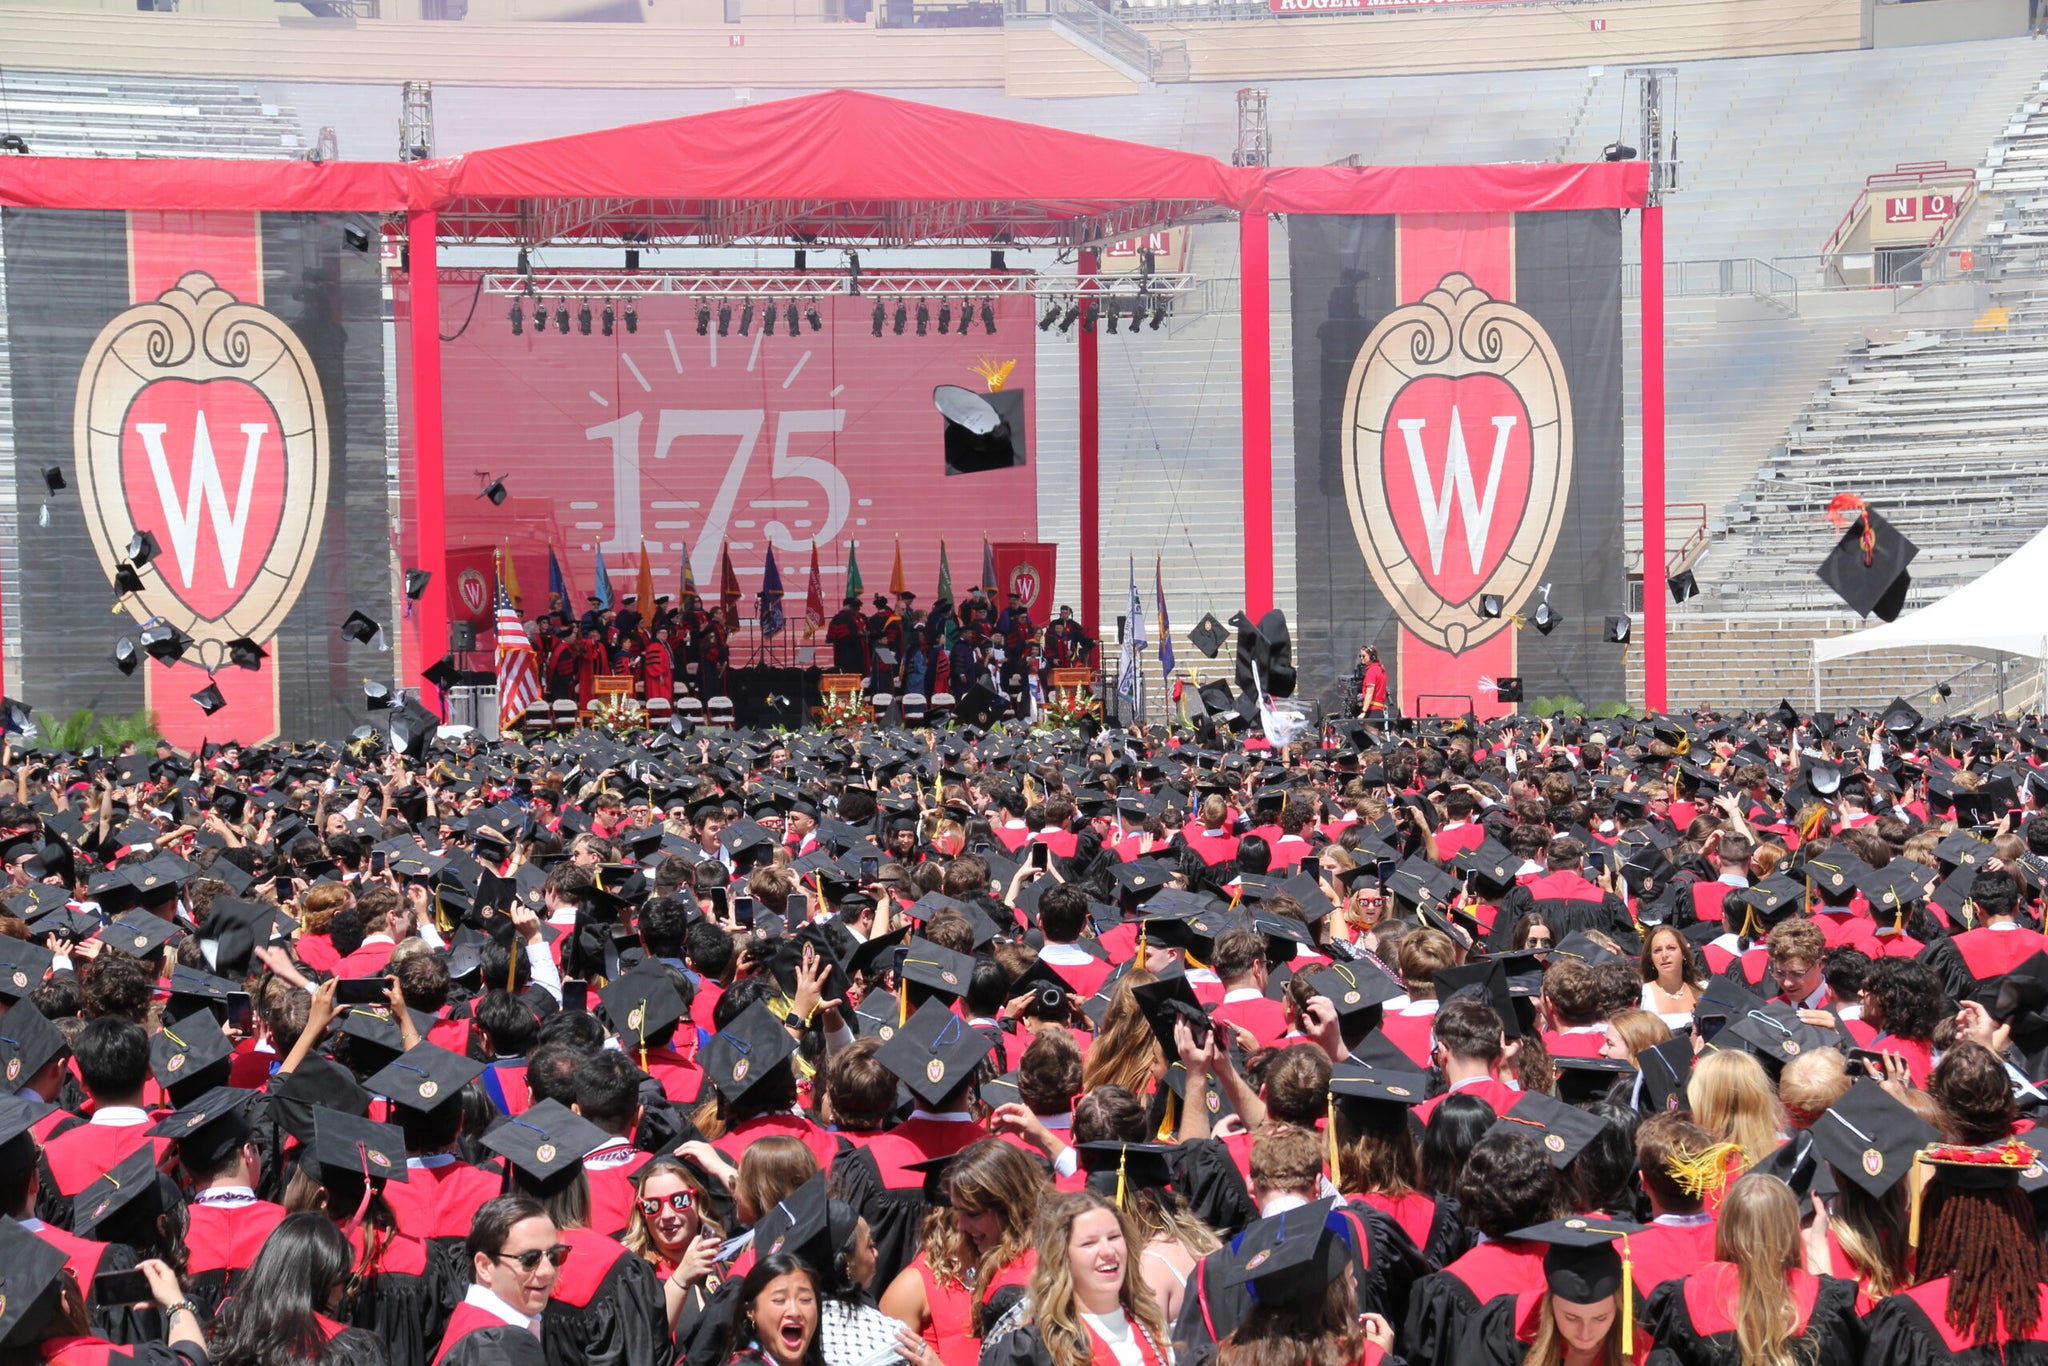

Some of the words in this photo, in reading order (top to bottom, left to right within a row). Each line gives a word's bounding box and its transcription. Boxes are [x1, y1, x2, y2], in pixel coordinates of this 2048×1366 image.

[1894, 199, 1907, 215] N
[1931, 196, 1944, 212] O
[1149, 232, 1160, 249] N
[136, 409, 268, 588] W
[585, 408, 850, 586] 175
[1397, 405, 1517, 575] W
[465, 583, 479, 605] W
[1017, 577, 1032, 600] W
[674, 1194, 690, 1208] 24
